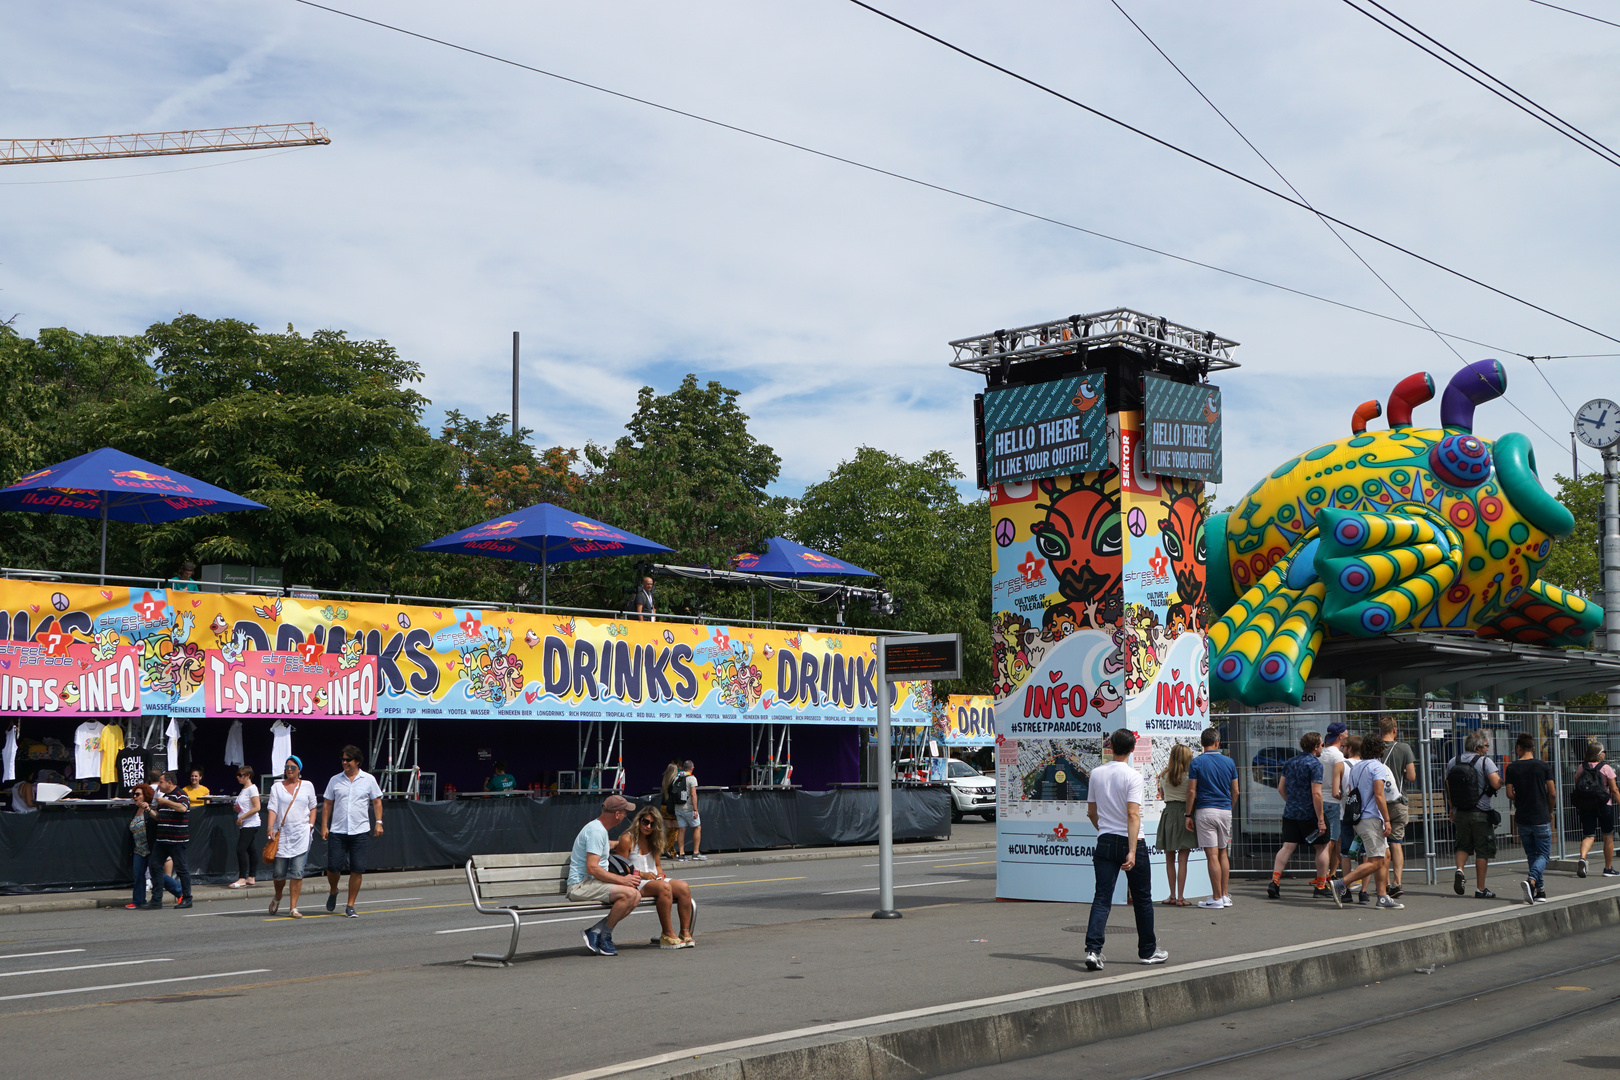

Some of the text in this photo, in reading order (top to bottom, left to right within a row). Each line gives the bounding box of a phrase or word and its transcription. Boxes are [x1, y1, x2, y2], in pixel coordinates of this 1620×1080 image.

[995, 426, 1036, 456] HELLO
[1038, 416, 1080, 446] THERE
[1153, 422, 1208, 448] HELLO THERE
[995, 461, 999, 478] I
[1001, 457, 1022, 477] LIKE
[1024, 451, 1050, 471] YOUR
[1052, 442, 1089, 466] OUTFIT!
[1122, 435, 1130, 487] SEKTOR
[1152, 450, 1213, 470] I LIKE YOUR OUTFIT!
[112, 478, 194, 494] Red Bull
[994, 574, 1027, 592] street
[1124, 568, 1156, 582] street
[1141, 573, 1170, 590] parade
[1007, 576, 1048, 598] parade
[1014, 593, 1046, 606] CULTURE OF
[1019, 599, 1052, 612] TOLERANCE
[99, 612, 145, 627] street
[120, 617, 169, 633] parade
[436, 632, 467, 642] street
[453, 635, 487, 648] parade
[0, 641, 47, 657] street
[18, 653, 74, 668] parade
[261, 652, 305, 664] street
[283, 662, 324, 675] parade
[542, 635, 699, 703] DRINKS
[0, 655, 138, 712] IRTS INFO
[210, 655, 314, 715] T-SHIRTS
[327, 663, 375, 716] INFO
[777, 648, 898, 708] DRINK
[1024, 683, 1088, 719] INFO
[1156, 681, 1195, 717] INFO
[170, 706, 201, 714] HEINEKEN
[957, 706, 995, 736] DRIN
[1011, 721, 1102, 733] #STREETPARADE2018
[121, 755, 144, 766] PAUL
[122, 764, 144, 774] KALK
[123, 772, 145, 781] BREN
[1008, 843, 1096, 858] #CULTUREOFTOLERAN
